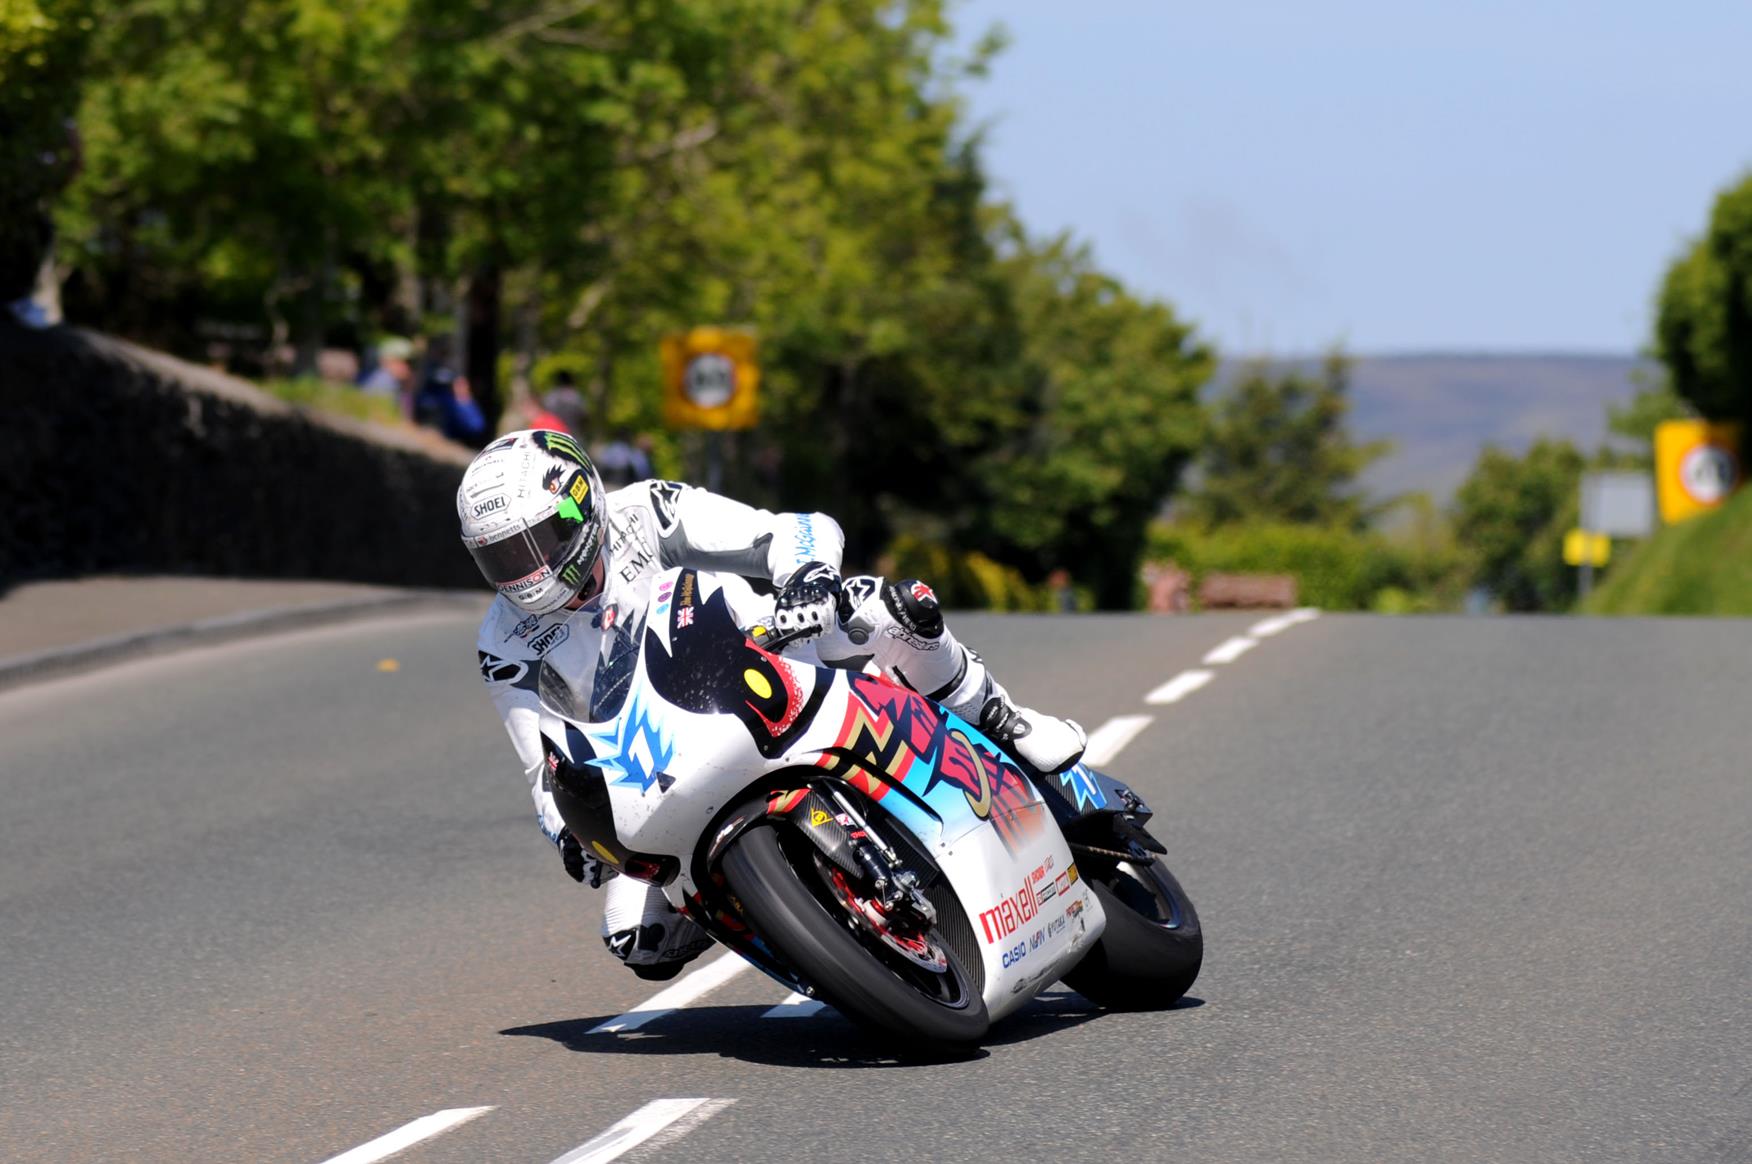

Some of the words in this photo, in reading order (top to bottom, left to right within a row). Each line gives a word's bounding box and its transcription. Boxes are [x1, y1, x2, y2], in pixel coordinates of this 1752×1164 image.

[474, 496, 506, 517] SHOEI
[488, 524, 521, 542] bennetts
[497, 569, 550, 593] DENNISON
[532, 625, 566, 656] SHOEI
[979, 875, 1039, 945] maxell
[1002, 941, 1027, 969] CASIO
